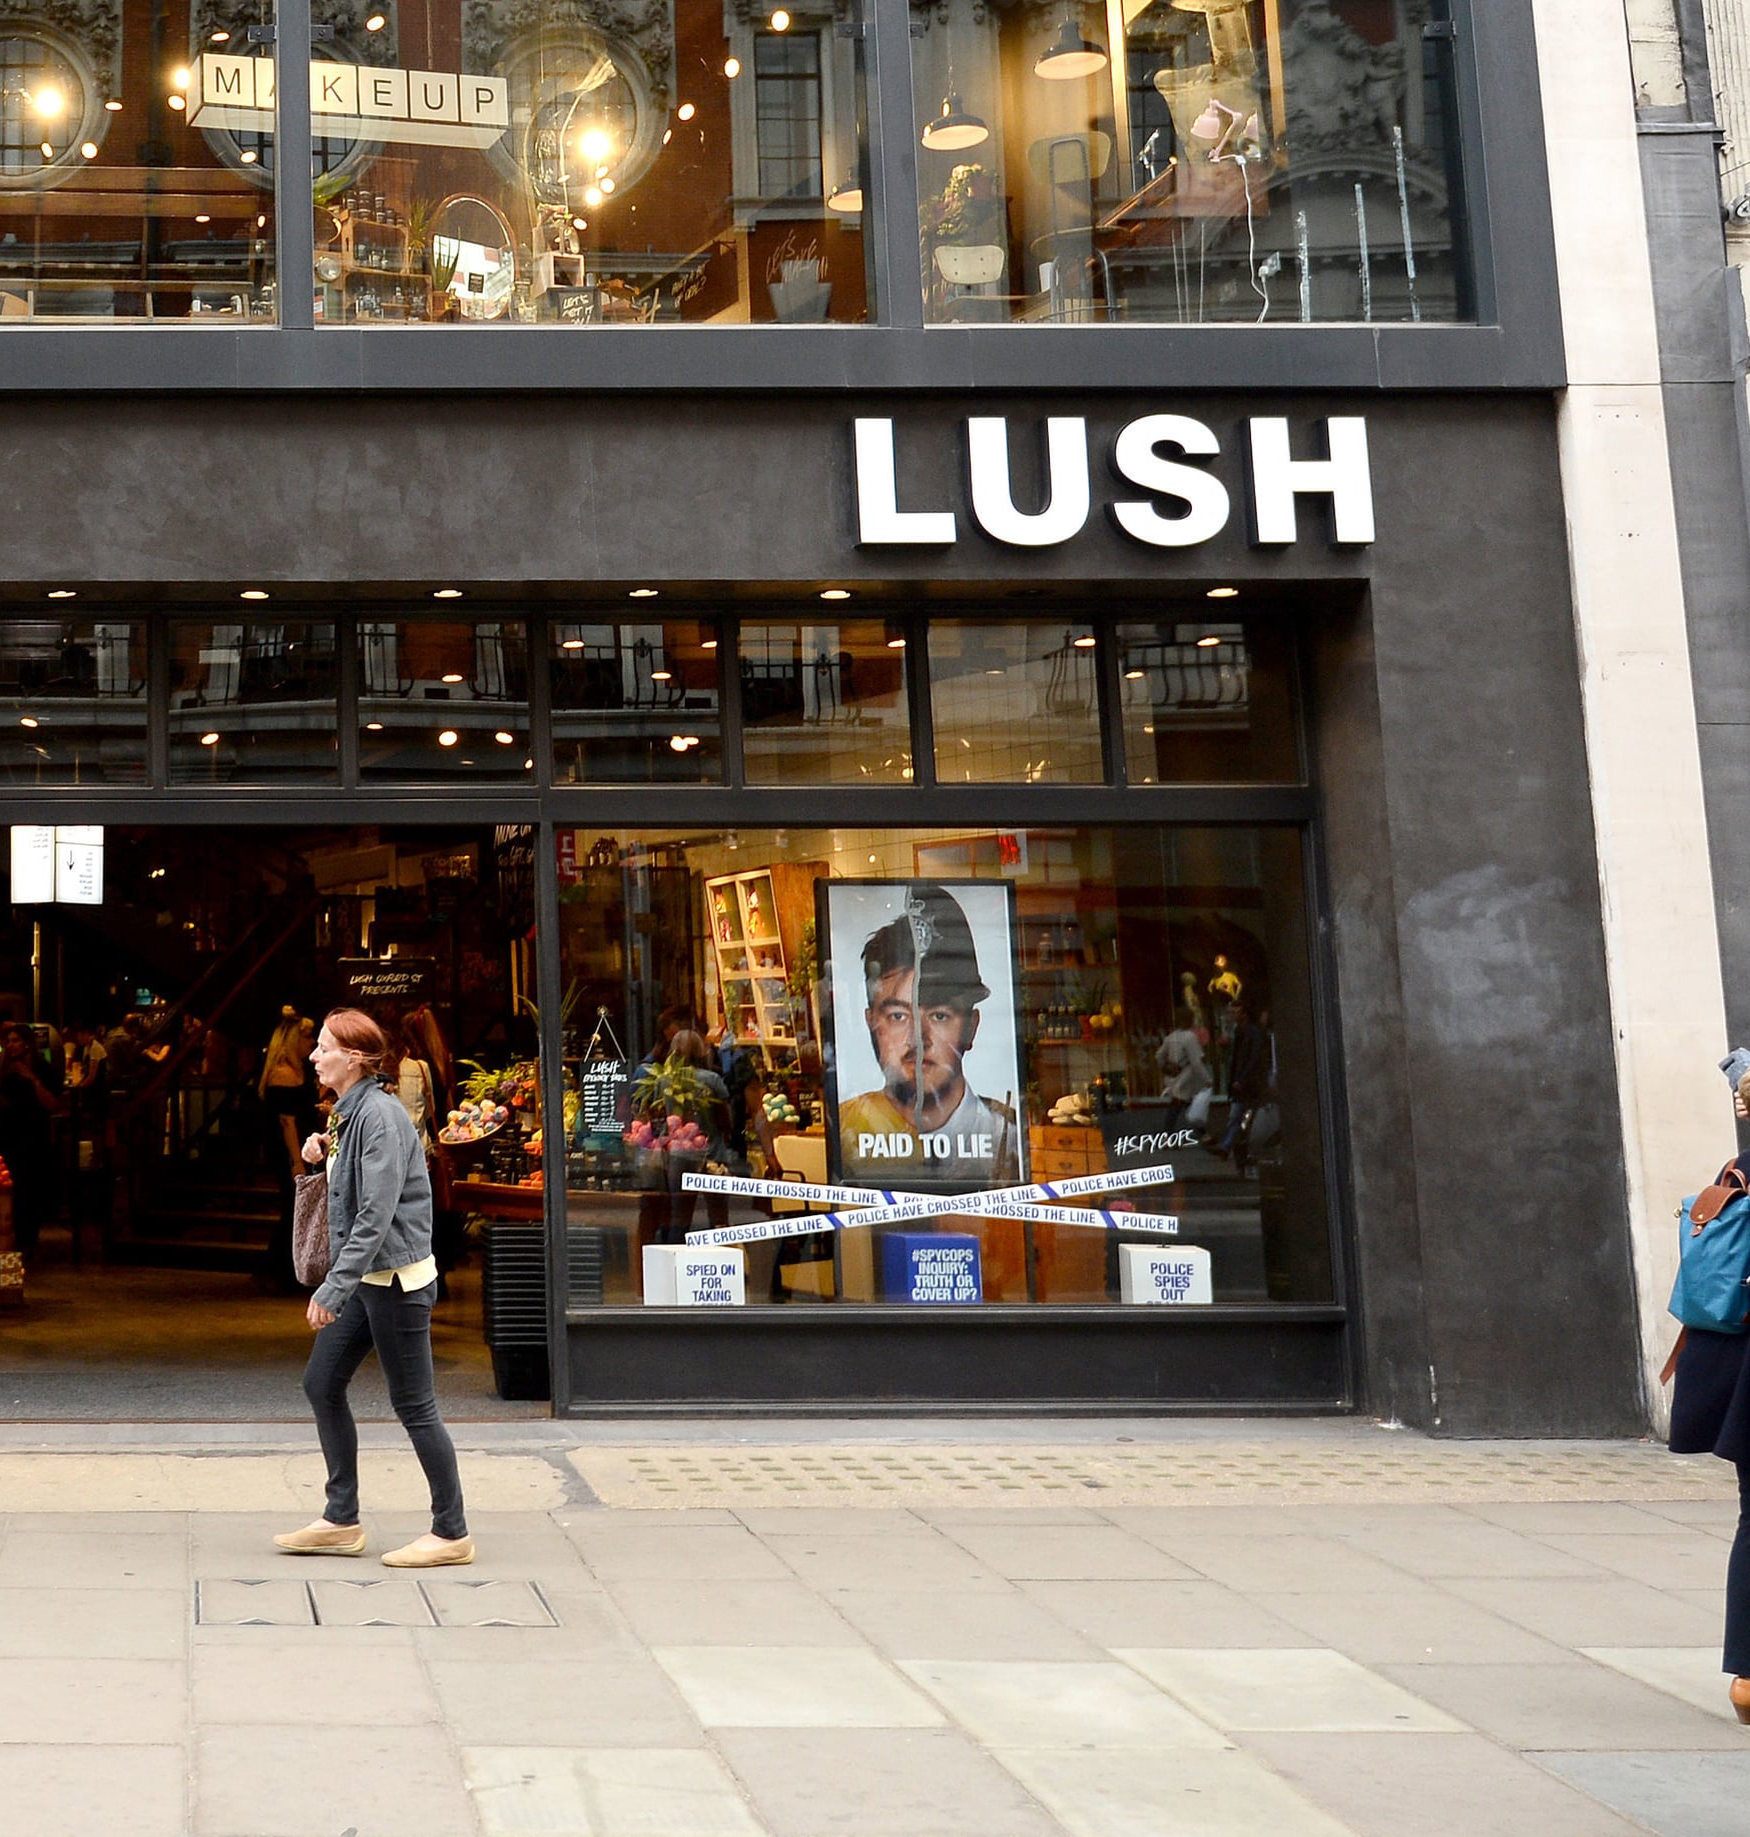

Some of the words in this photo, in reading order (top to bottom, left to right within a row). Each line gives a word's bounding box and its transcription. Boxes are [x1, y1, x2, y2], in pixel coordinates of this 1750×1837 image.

[215, 66, 495, 113] MKEUP
[854, 413, 1376, 547] LUSH
[858, 1133, 913, 1158] PAID
[919, 1133, 951, 1158] TO
[956, 1133, 994, 1158] LIE
[1113, 1129, 1199, 1156] #SPYCOPS
[686, 1176, 727, 1191] POLICE
[731, 1179, 763, 1194] HAVE
[766, 1183, 821, 1199] CROSSED
[825, 1188, 847, 1201] THE
[851, 1191, 878, 1204] LINE
[1043, 1208, 1066, 1222] THE
[1069, 1211, 1096, 1224] LINE
[1122, 1216, 1163, 1230] POLICE
[1168, 1219, 1176, 1231] H
[687, 1234, 709, 1247] AVE
[713, 1227, 767, 1244] CROSSED
[770, 1221, 794, 1236] THE
[797, 1218, 823, 1231] LINE
[848, 1207, 890, 1225] POLICE
[893, 1203, 924, 1219] HAVE
[927, 1196, 982, 1213] CROSSED
[984, 1191, 1008, 1205] THE
[1011, 1187, 1038, 1201] LINE
[1062, 1178, 1104, 1194] POLICE
[1107, 1172, 1138, 1188] HAVE
[1141, 1167, 1172, 1183] CROS
[912, 1248, 974, 1262] #SPYCOPS
[686, 1264, 717, 1276] SPIED
[720, 1264, 736, 1276] ON
[918, 1261, 968, 1275] INQUIRY:
[1150, 1262, 1194, 1276] POLICE
[701, 1277, 722, 1289] FOR
[914, 1274, 953, 1288] TRUTH
[956, 1274, 974, 1288] OR
[1154, 1275, 1191, 1288] SPIES
[692, 1289, 732, 1303] TAKING
[912, 1287, 951, 1301] COVER
[954, 1287, 977, 1301] UP?
[1161, 1288, 1186, 1301] OUT
